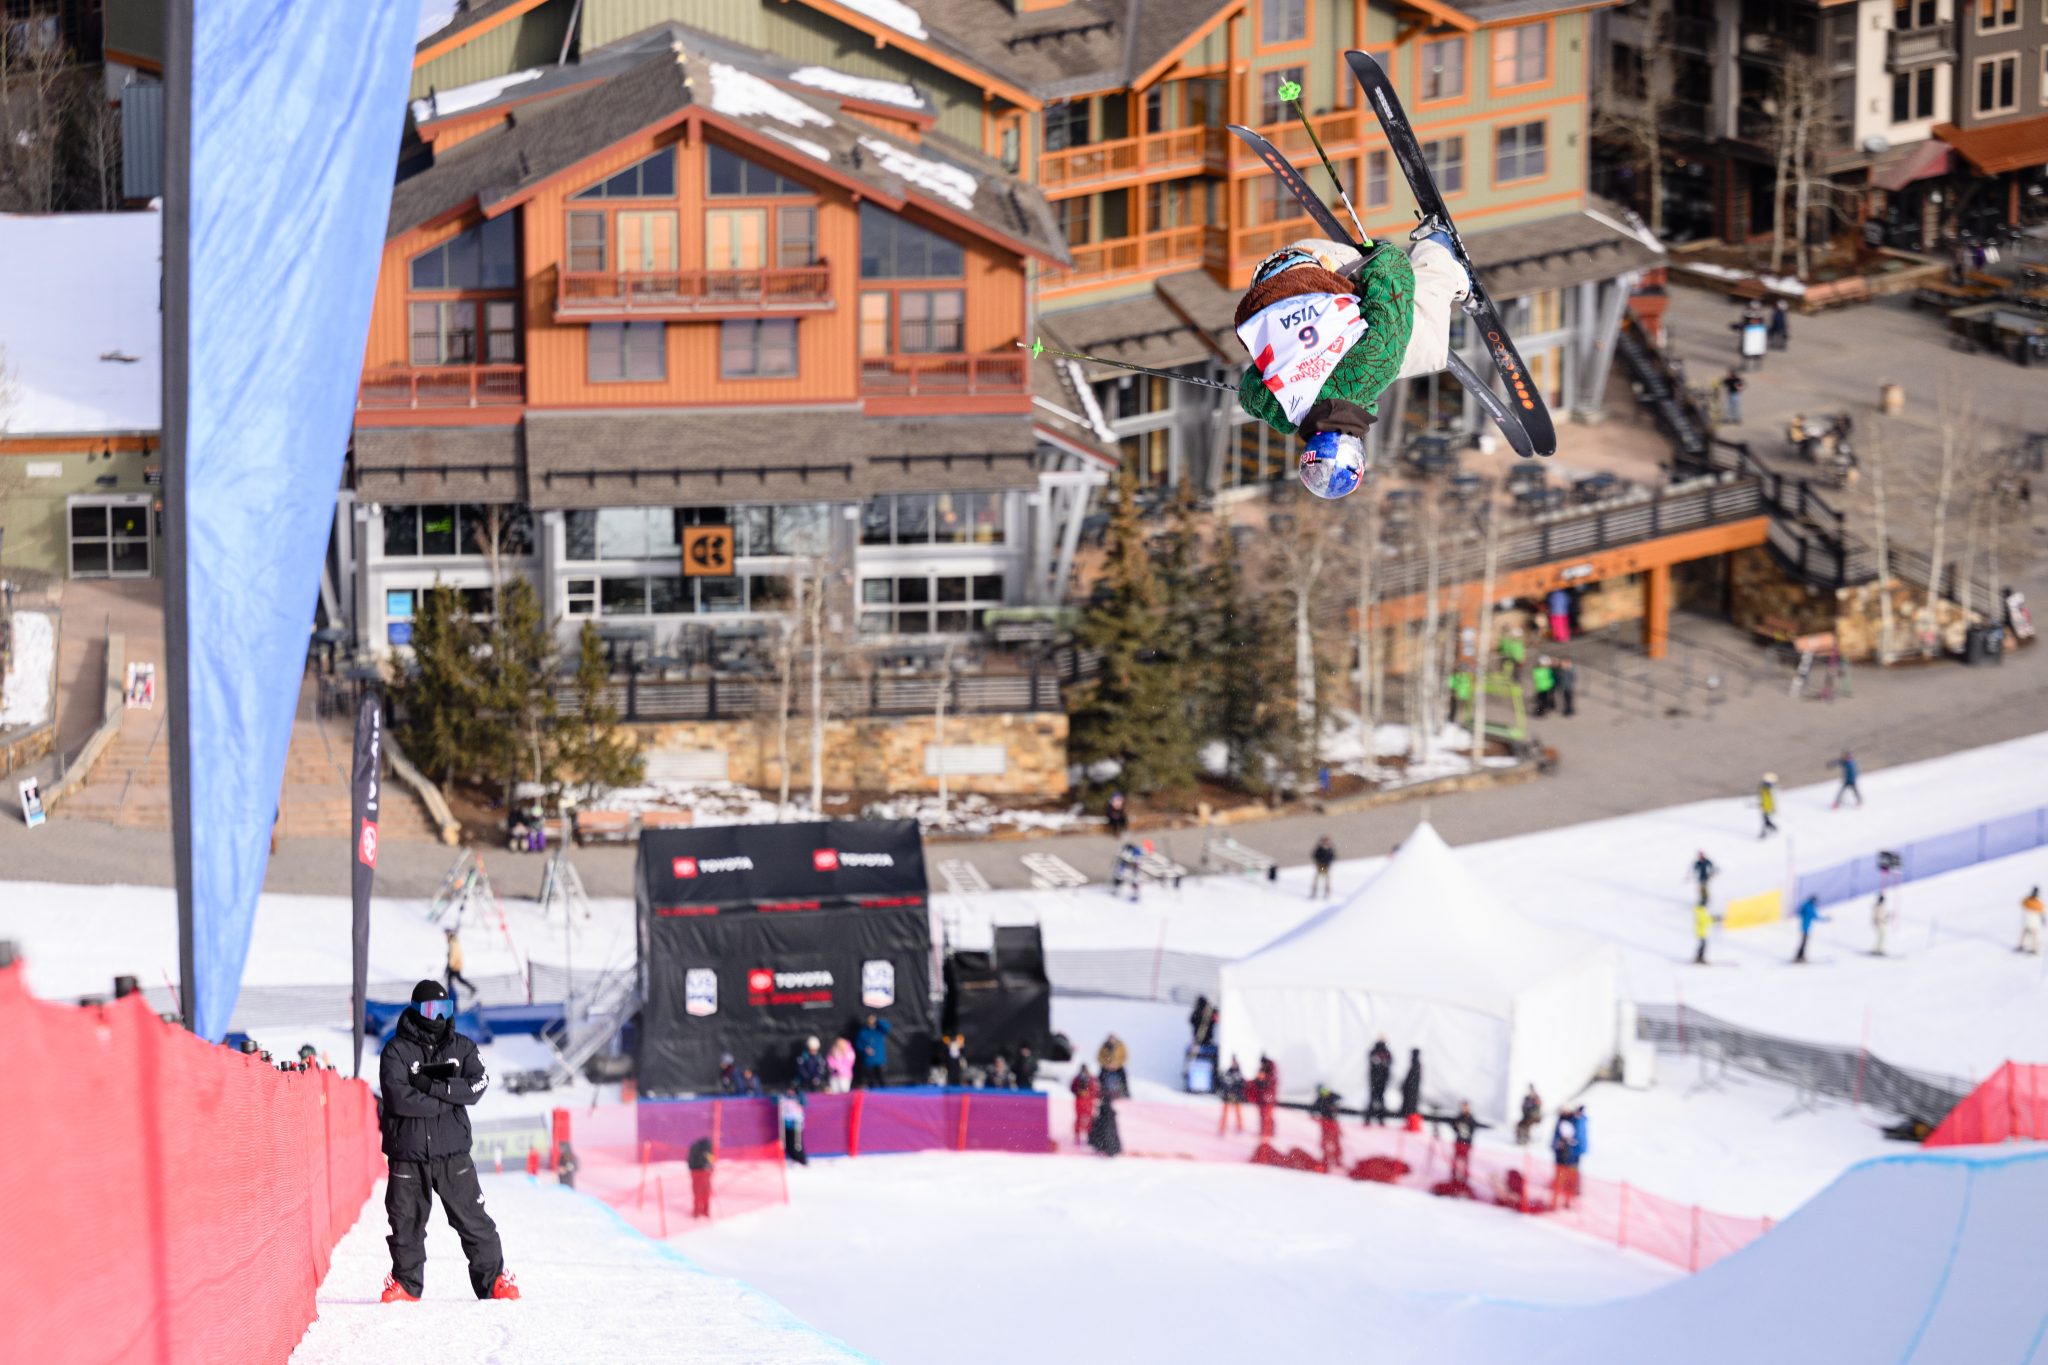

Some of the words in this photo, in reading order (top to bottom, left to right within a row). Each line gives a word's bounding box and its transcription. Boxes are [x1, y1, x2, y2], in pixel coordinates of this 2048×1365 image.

[1279, 305, 1320, 330] VISA
[1298, 325, 1319, 349] 6
[1290, 358, 1328, 384] GRAND
[698, 856, 754, 873] TOYOTA
[838, 852, 894, 867] TOYOTA
[774, 970, 834, 988] TOYOTA
